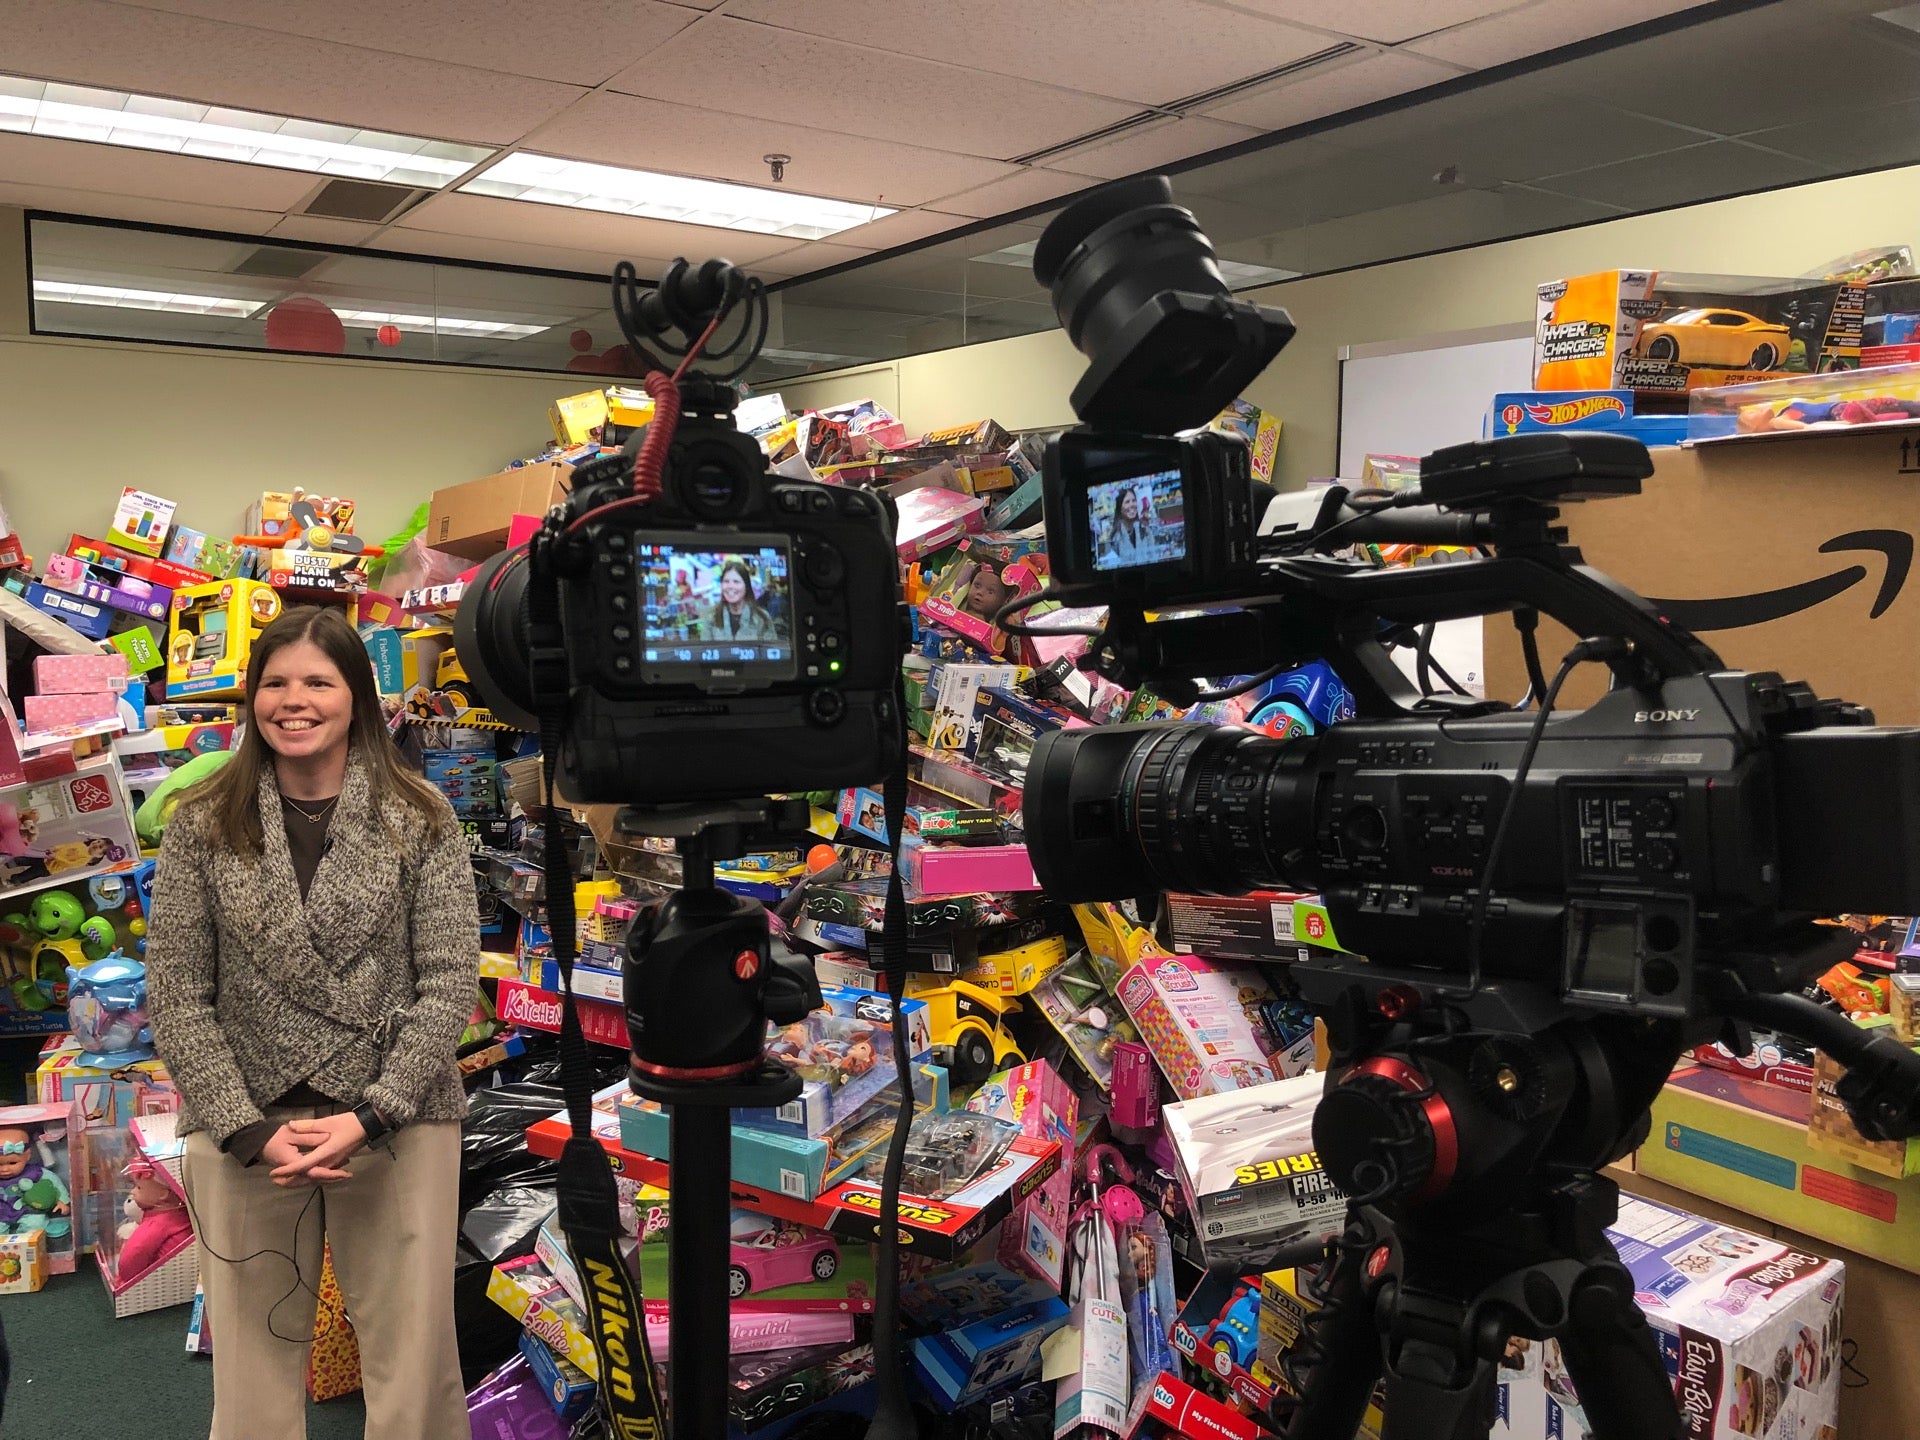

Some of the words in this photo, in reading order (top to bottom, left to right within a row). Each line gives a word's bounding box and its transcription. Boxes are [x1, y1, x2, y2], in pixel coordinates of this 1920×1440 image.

[1542, 320, 1587, 344] HYPER
[1543, 336, 1606, 357] CHARGERS
[1621, 358, 1668, 374] HYPER
[1623, 373, 1687, 387] CHARGERS
[1252, 427, 1276, 481] Barbie
[295, 555, 331, 566] DUSTY
[294, 566, 330, 577] PLANE
[288, 576, 315, 586] RIDE
[317, 578, 336, 588] ON
[131, 637, 146, 665] Tractor
[140, 639, 151, 658] Farm
[1634, 709, 1700, 723] SONY
[196, 734, 205, 747] 4
[72, 779, 111, 804] STEP
[78, 797, 93, 813] 2
[922, 819, 954, 830] BLOX
[738, 860, 760, 869] RACER
[142, 880, 154, 890] vt
[1310, 926, 1323, 936] 142
[1161, 971, 1190, 982] kawaii
[1169, 979, 1195, 990] crush
[1126, 981, 1147, 1001] kawaii
[959, 1000, 971, 1011] CAT
[1131, 989, 1151, 1010] crush
[1013, 1084, 1028, 1121] duplo
[848, 1193, 952, 1225] SUER
[1297, 1194, 1327, 1208] B-58
[1091, 1306, 1117, 1321] CUTE
[521, 1296, 571, 1355] Barbie
[585, 1257, 636, 1402] Nikon
[1175, 1328, 1197, 1351] KID
[1155, 1388, 1174, 1405] KID
[1241, 1381, 1249, 1390] My
[1249, 1385, 1261, 1398] First
[1241, 1388, 1259, 1404] Vehicle
[1192, 1410, 1203, 1422] My
[1203, 1414, 1220, 1431] First
